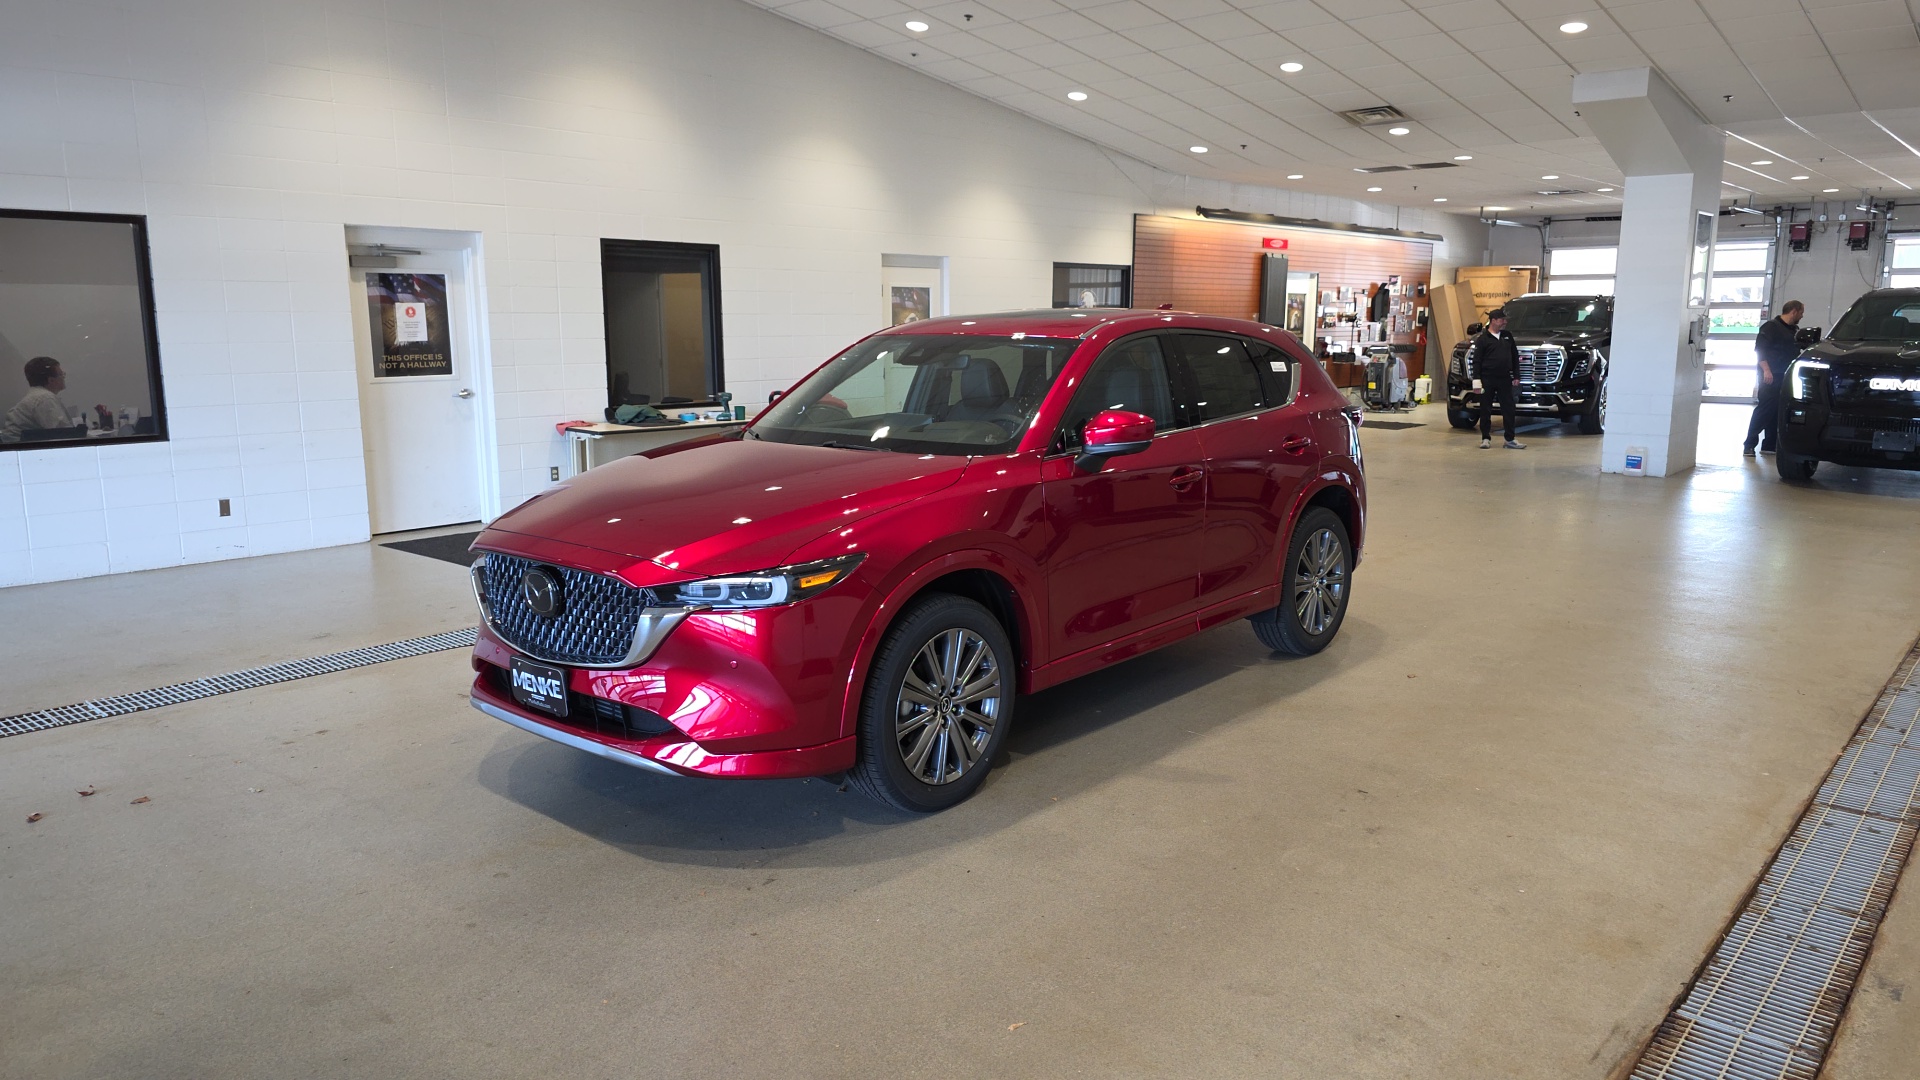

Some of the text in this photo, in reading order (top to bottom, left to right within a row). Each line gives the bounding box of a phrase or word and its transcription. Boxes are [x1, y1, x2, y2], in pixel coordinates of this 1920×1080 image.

[382, 354, 402, 362] THIS
[403, 353, 434, 361] OFFICE
[407, 360, 447, 368] HALLWAY
[512, 668, 562, 699] MENKE
